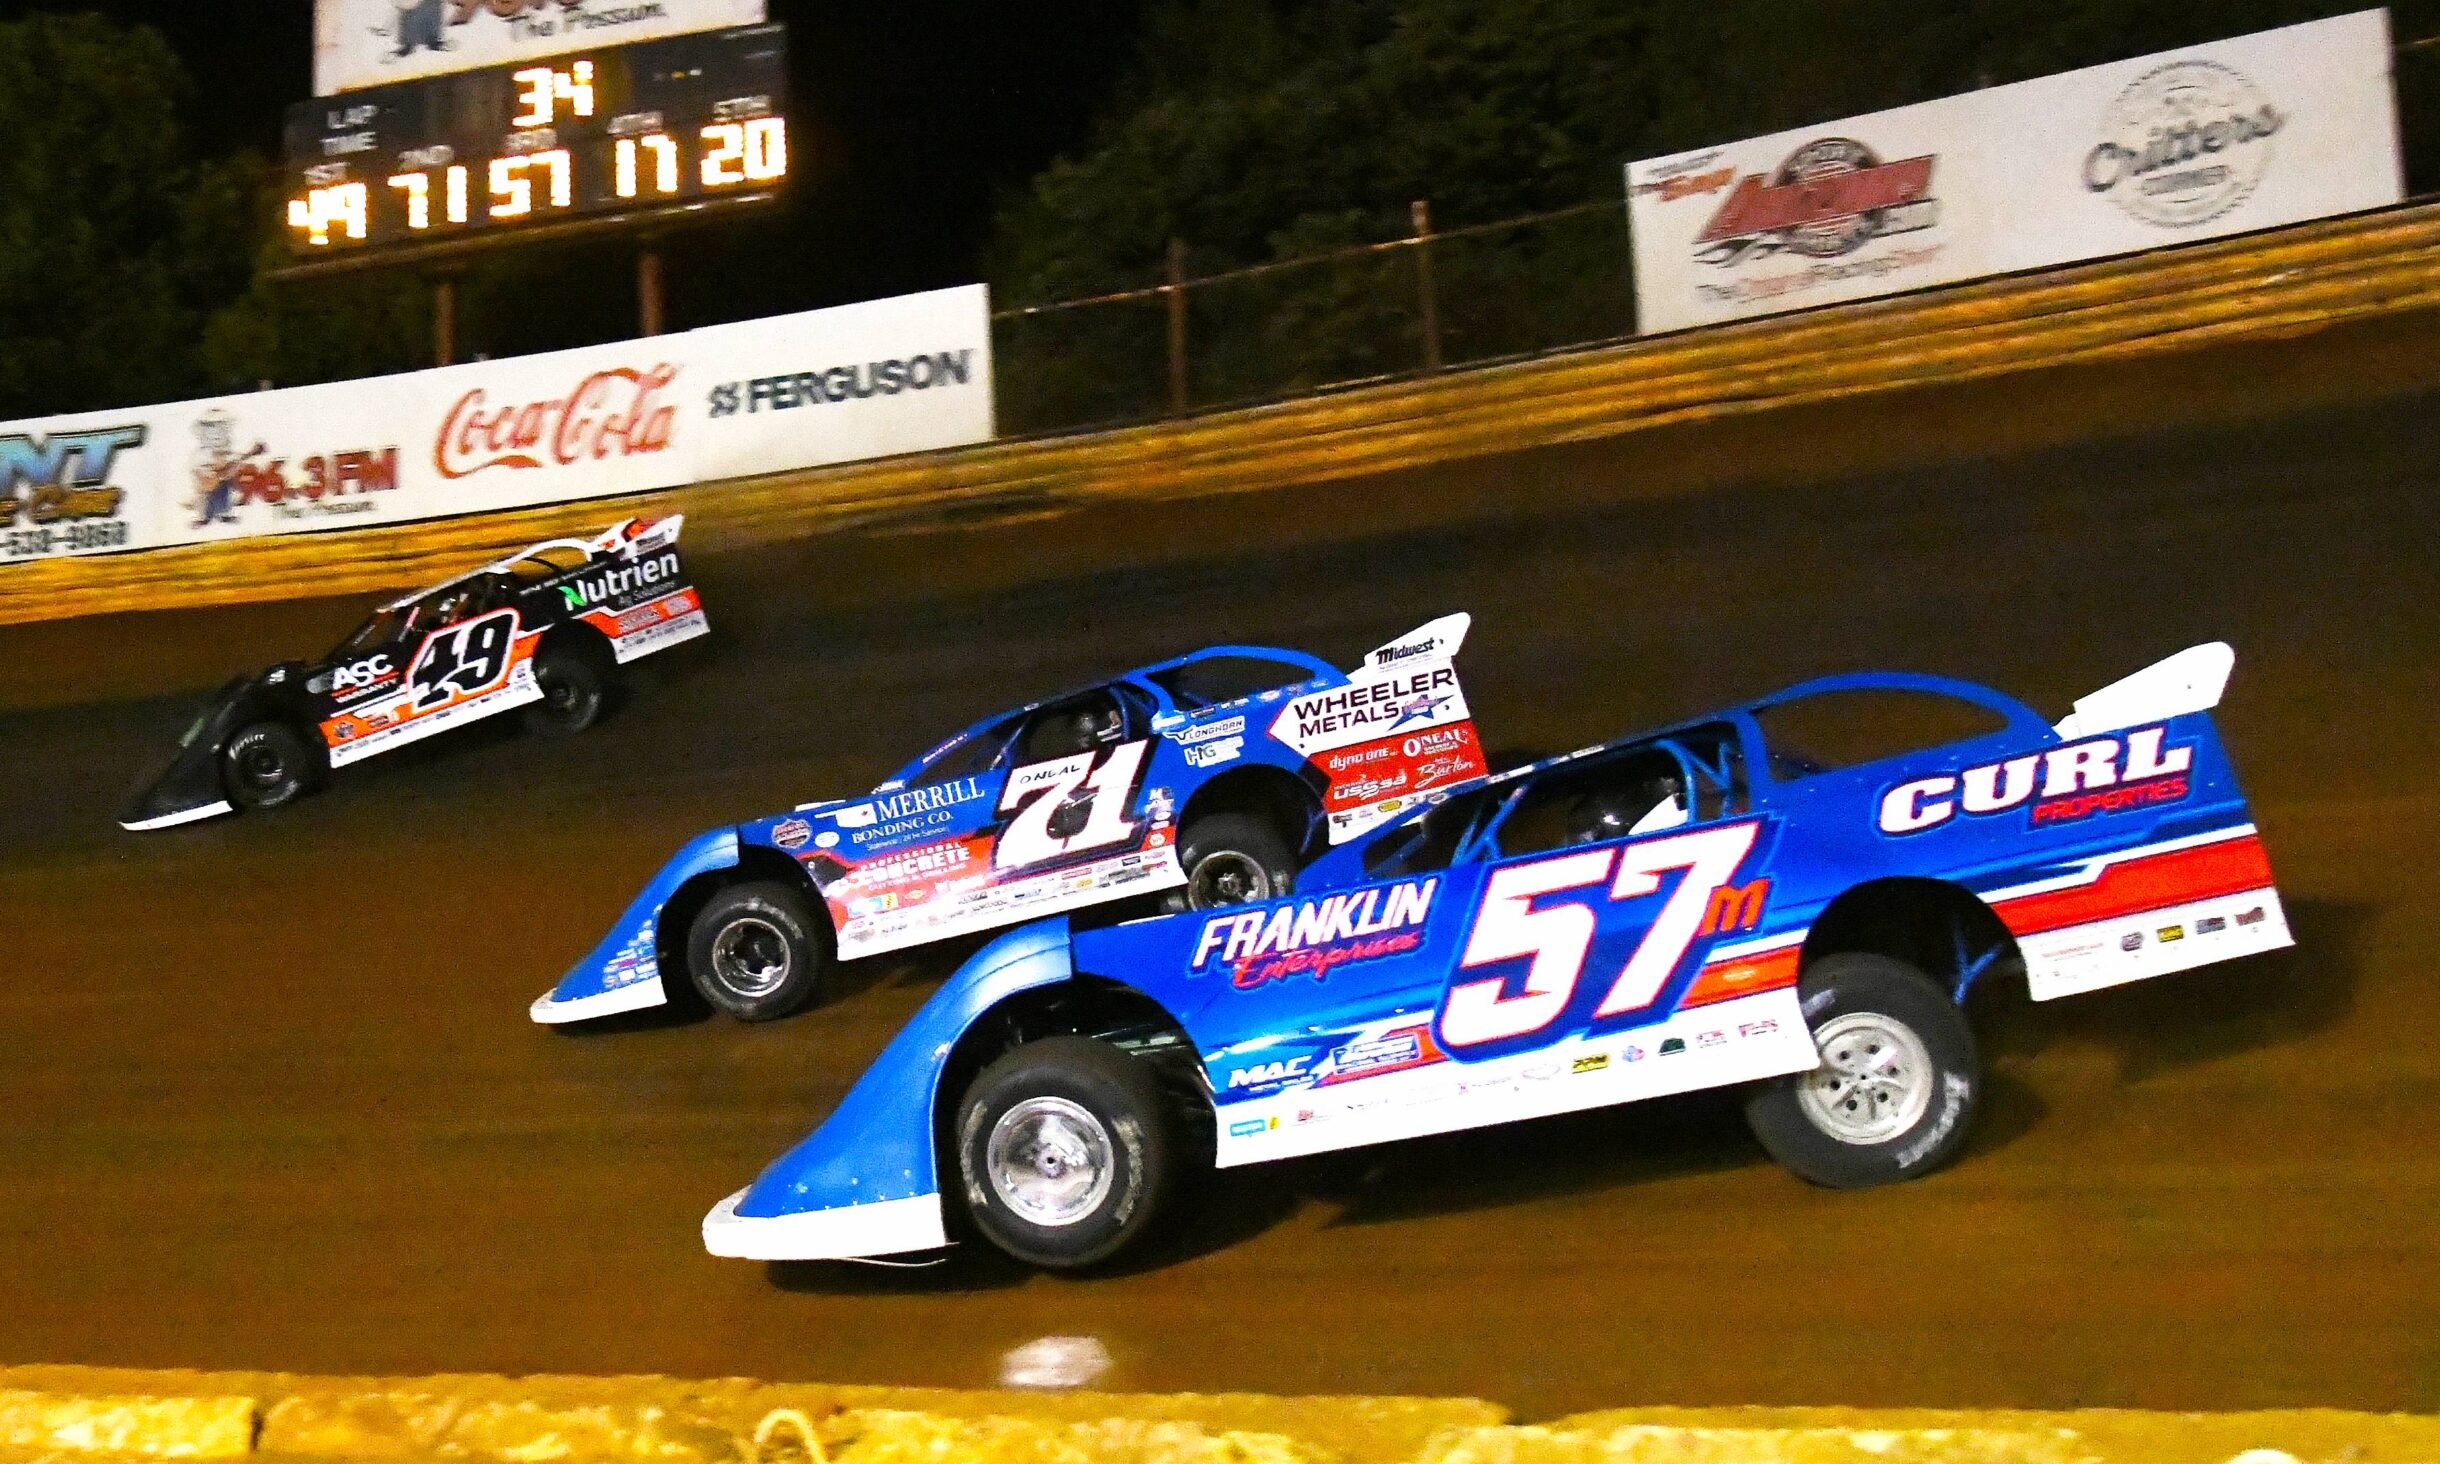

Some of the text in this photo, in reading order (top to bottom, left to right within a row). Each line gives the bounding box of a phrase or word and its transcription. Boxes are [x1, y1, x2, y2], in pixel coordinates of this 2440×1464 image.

[513, 61, 593, 127] 34
[288, 117, 786, 245] 49 71 57 17 20
[748, 348, 974, 413] FERGUSON
[434, 361, 684, 479] Coca-Cola
[236, 446, 400, 506] 96.3 FM
[557, 553, 679, 612] Nutrien
[333, 653, 394, 690] ASC
[411, 611, 514, 708] 49
[1375, 637, 1435, 665] Midwest
[1293, 668, 1455, 719] WHEELER
[1300, 702, 1399, 738] METALS
[1189, 720, 1243, 739] LONGHORN
[876, 777, 986, 822] MERRILL
[1414, 755, 1474, 790] Burton
[1879, 726, 2192, 834] CURL
[852, 810, 954, 844] BONDING CO.
[996, 738, 1149, 868] 71
[1192, 878, 1438, 967] FRANKLIN
[1232, 931, 1420, 988] Enterprises
[1228, 1055, 1313, 1088] MAC
